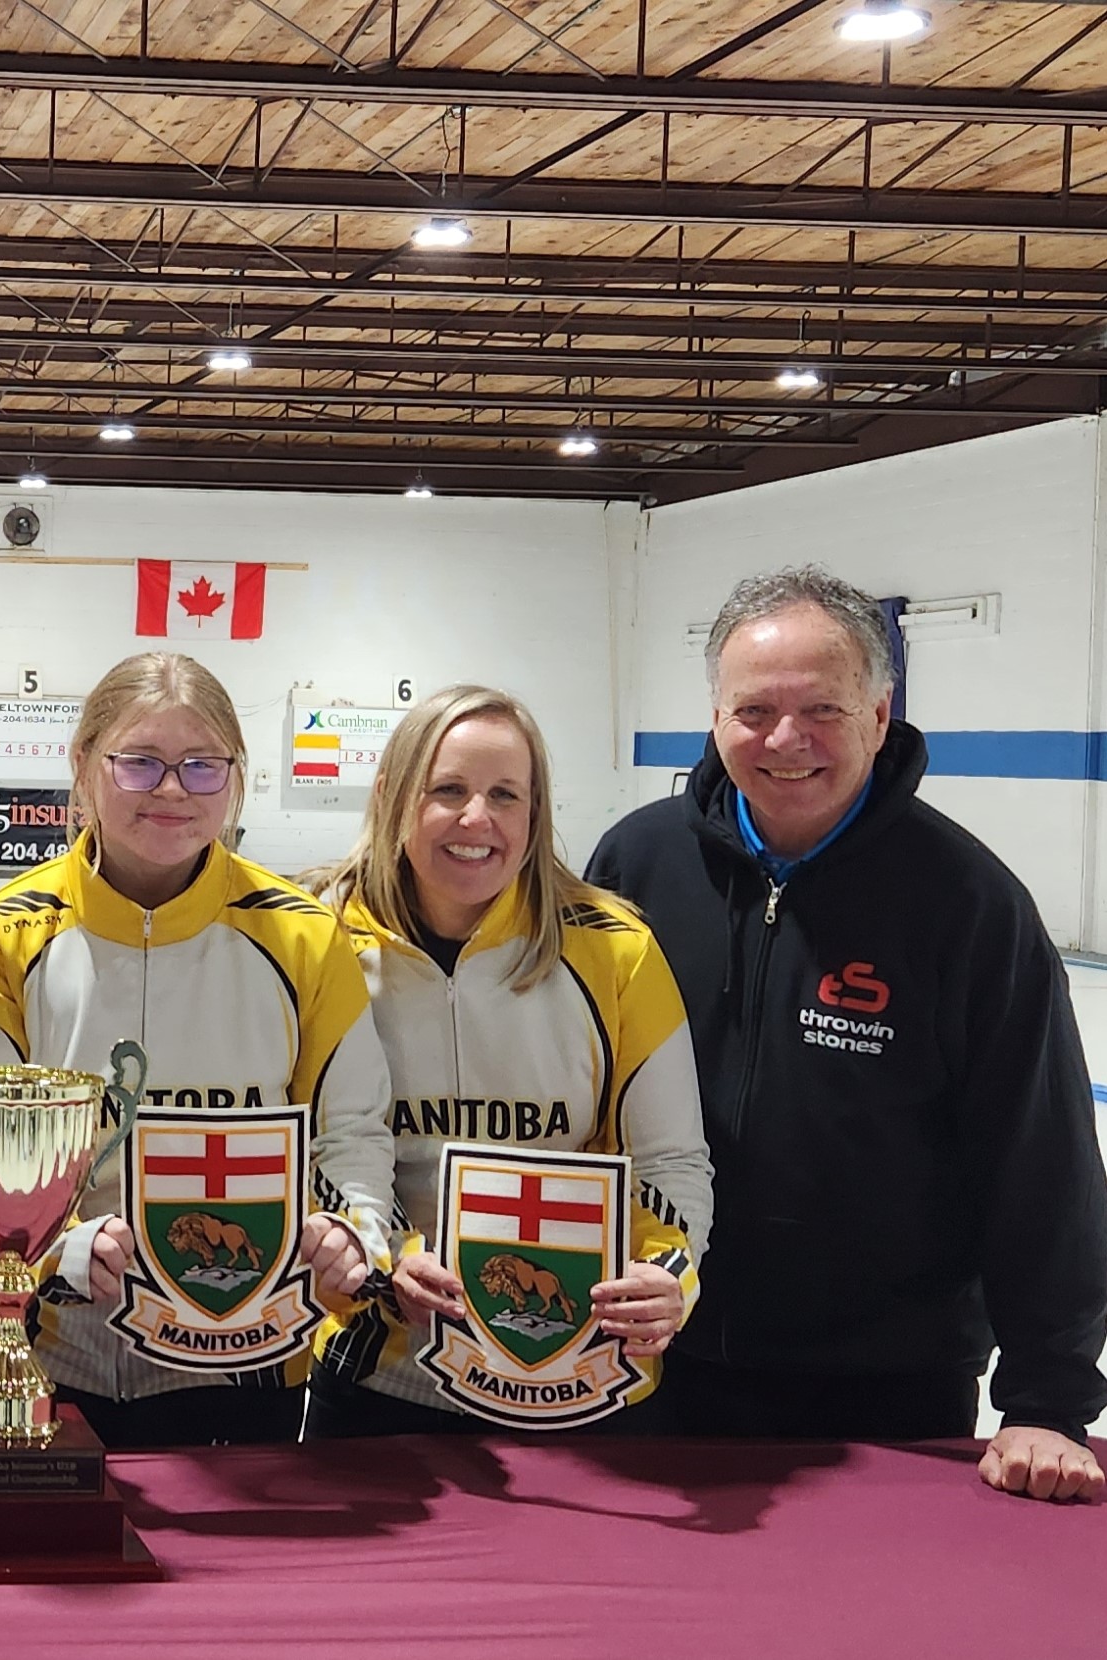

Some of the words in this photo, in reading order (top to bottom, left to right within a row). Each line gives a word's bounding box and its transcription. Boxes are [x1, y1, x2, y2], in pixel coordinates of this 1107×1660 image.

[24, 670, 38, 693] 5
[397, 679, 412, 702] 6
[328, 714, 388, 728] Cambrian
[5, 744, 13, 755] 4
[18, 744, 26, 755] 5
[31, 745, 39, 756] 6
[45, 745, 52, 756] 7
[58, 745, 66, 756] 8
[356, 752, 363, 762] 2
[369, 752, 377, 762] 3
[799, 1008, 895, 1041] throwin
[803, 1029, 884, 1055] stones
[392, 1098, 571, 1142] ANITOBA
[158, 1322, 281, 1351] MANITOBA
[466, 1365, 594, 1404] MANITOBA
